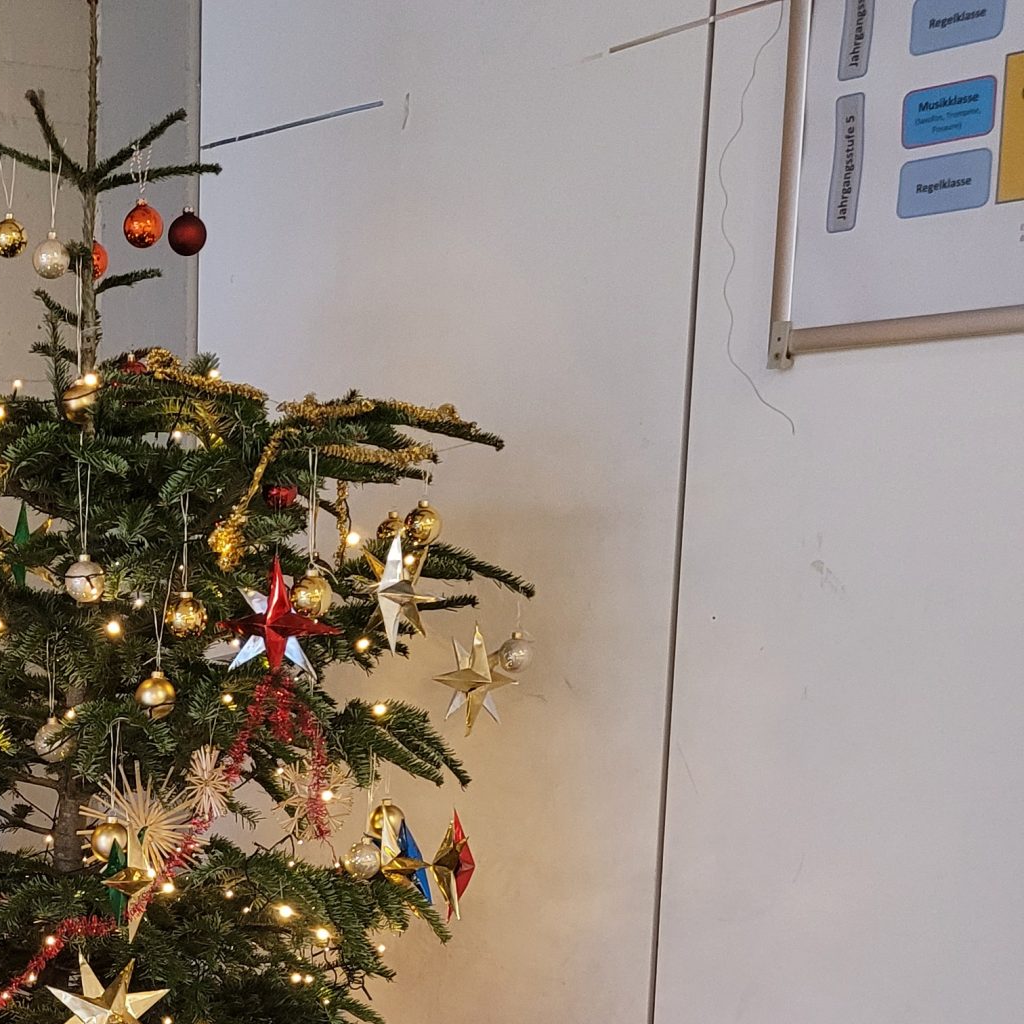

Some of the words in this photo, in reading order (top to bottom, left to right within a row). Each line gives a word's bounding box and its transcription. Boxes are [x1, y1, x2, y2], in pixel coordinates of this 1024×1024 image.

[928, 8, 987, 29] Regelklasse
[918, 93, 980, 112] Musikklasse
[845, 115, 855, 123] 5
[837, 126, 856, 221] Jahrgangsstufe
[916, 177, 972, 194] Regelklasse
